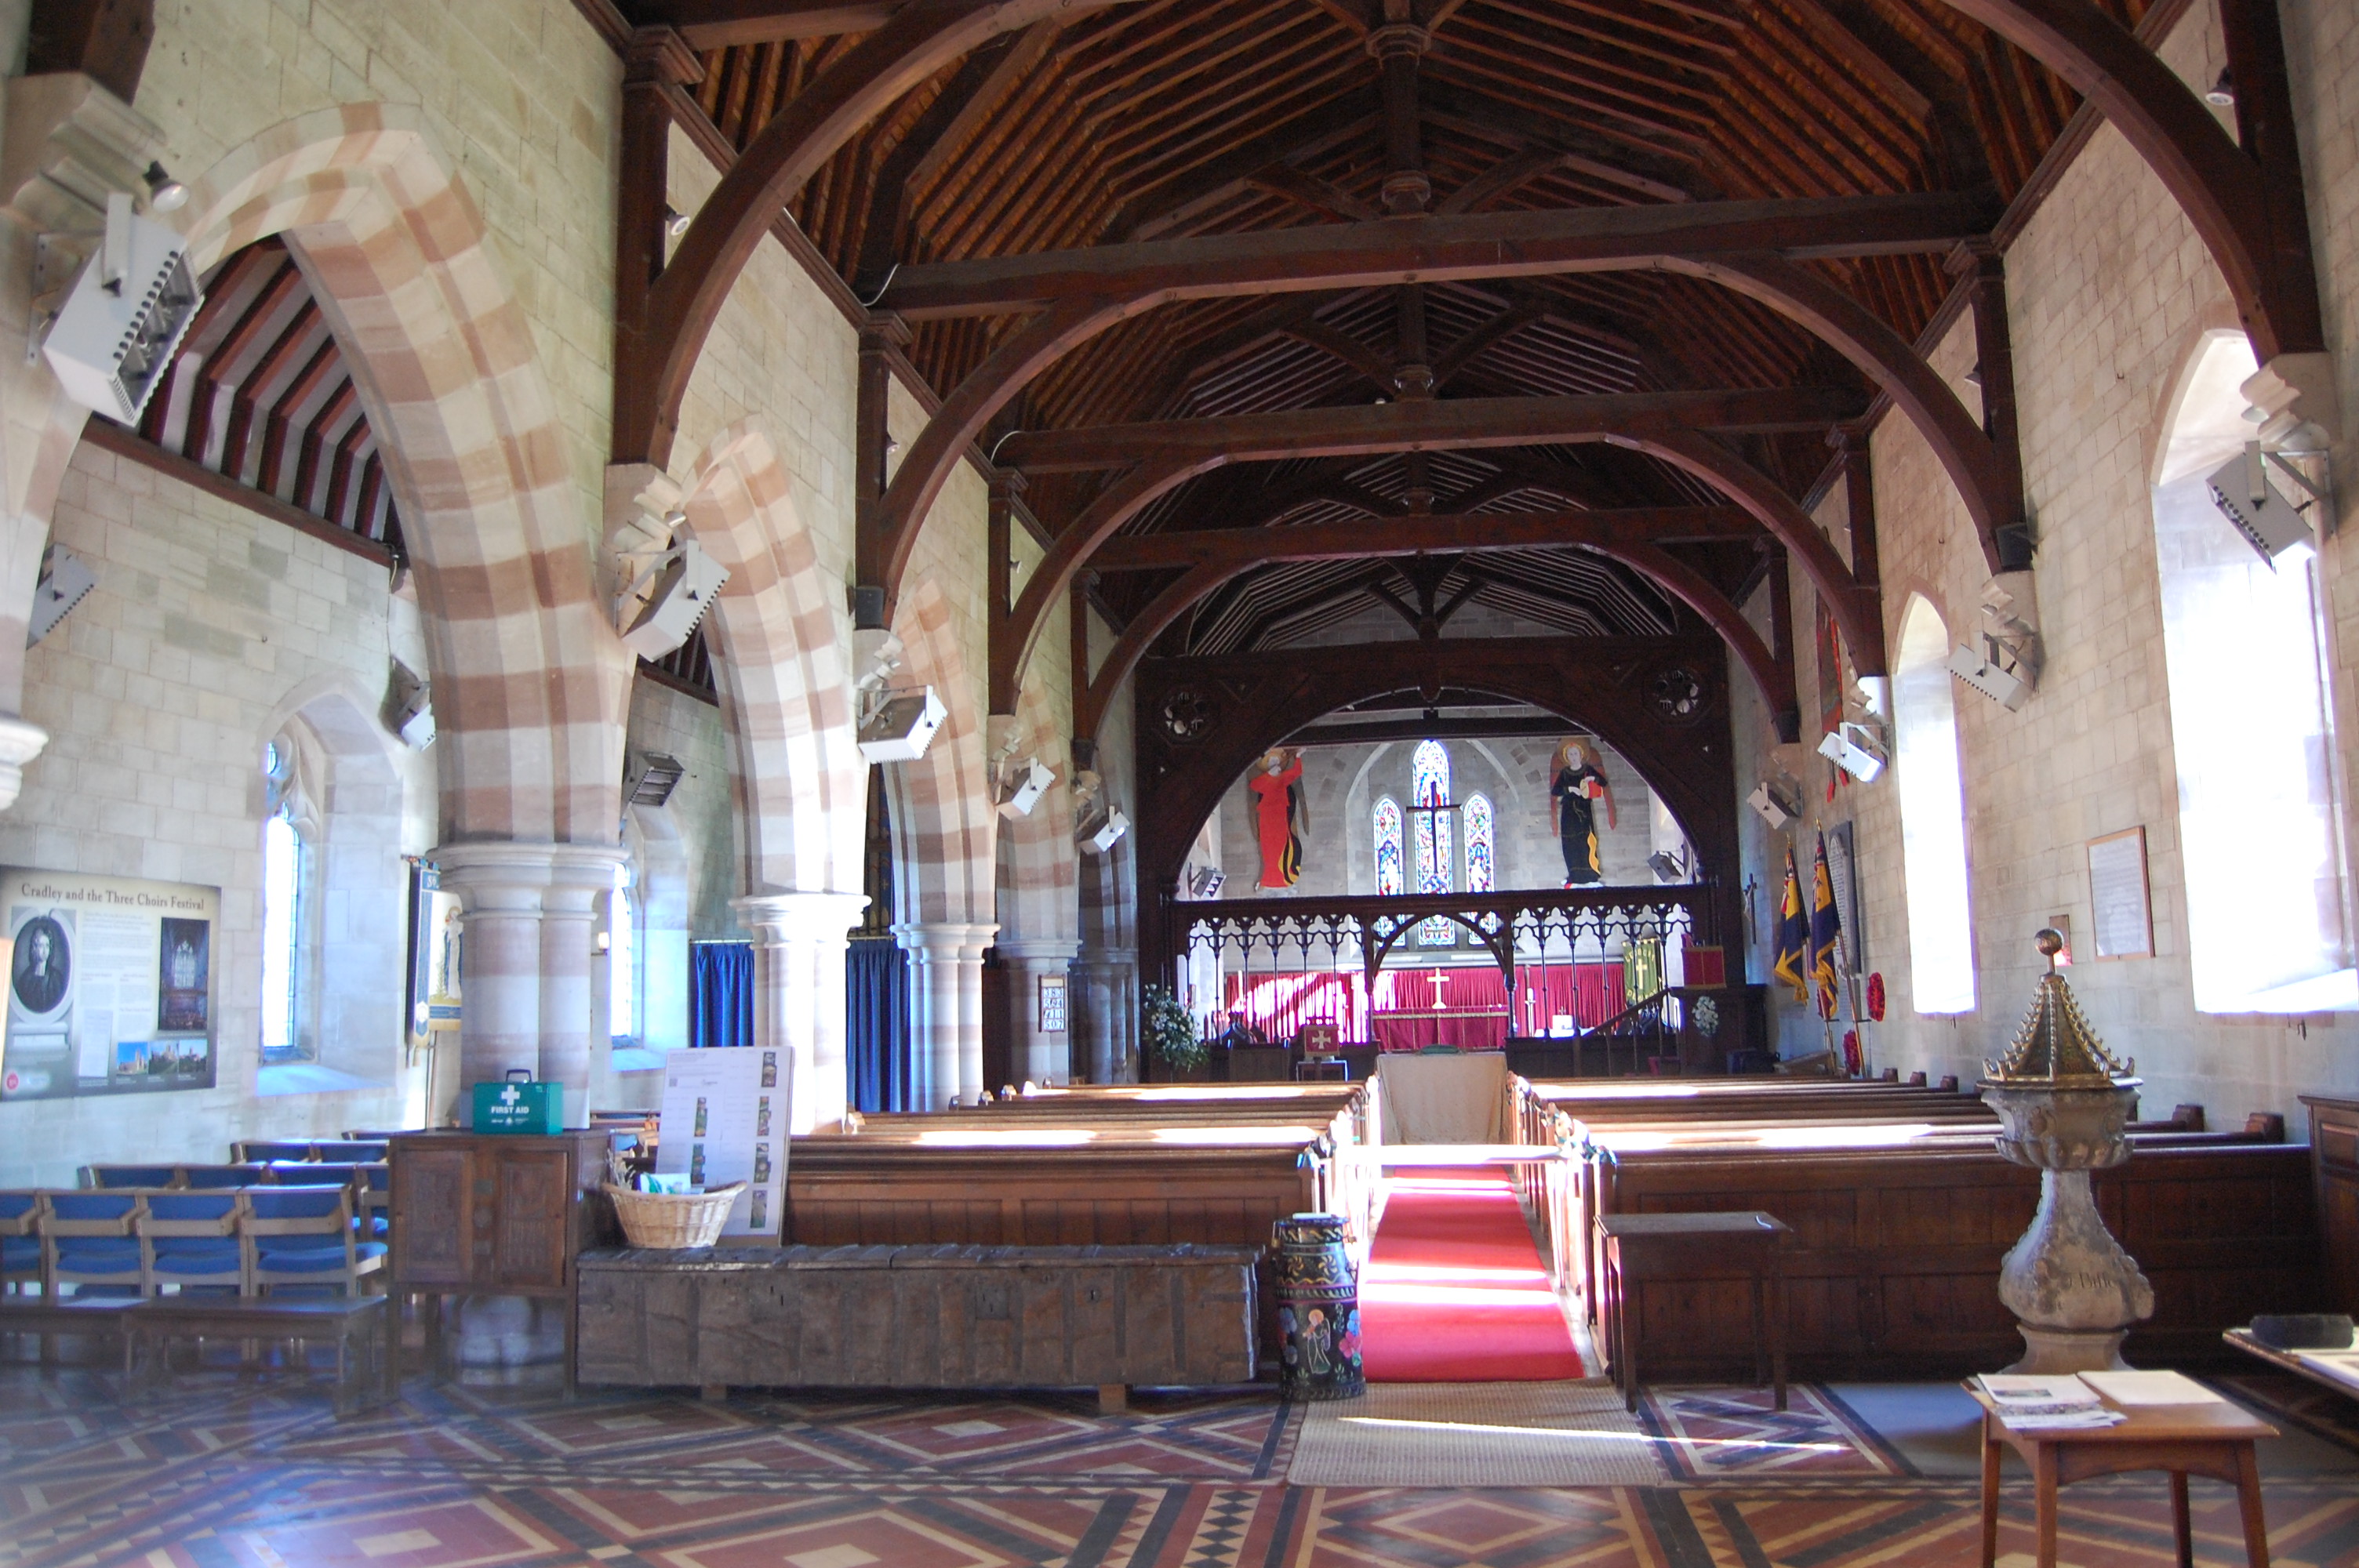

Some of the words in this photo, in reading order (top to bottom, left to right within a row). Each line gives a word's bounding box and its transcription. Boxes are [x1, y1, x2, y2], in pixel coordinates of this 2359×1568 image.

[21, 883, 62, 902] Cradley
[66, 887, 84, 901] and
[87, 890, 103, 902] the
[106, 891, 134, 904] Three
[137, 893, 168, 906] Choirs
[171, 896, 205, 910] Festival
[1045, 1019, 1063, 1029] 507
